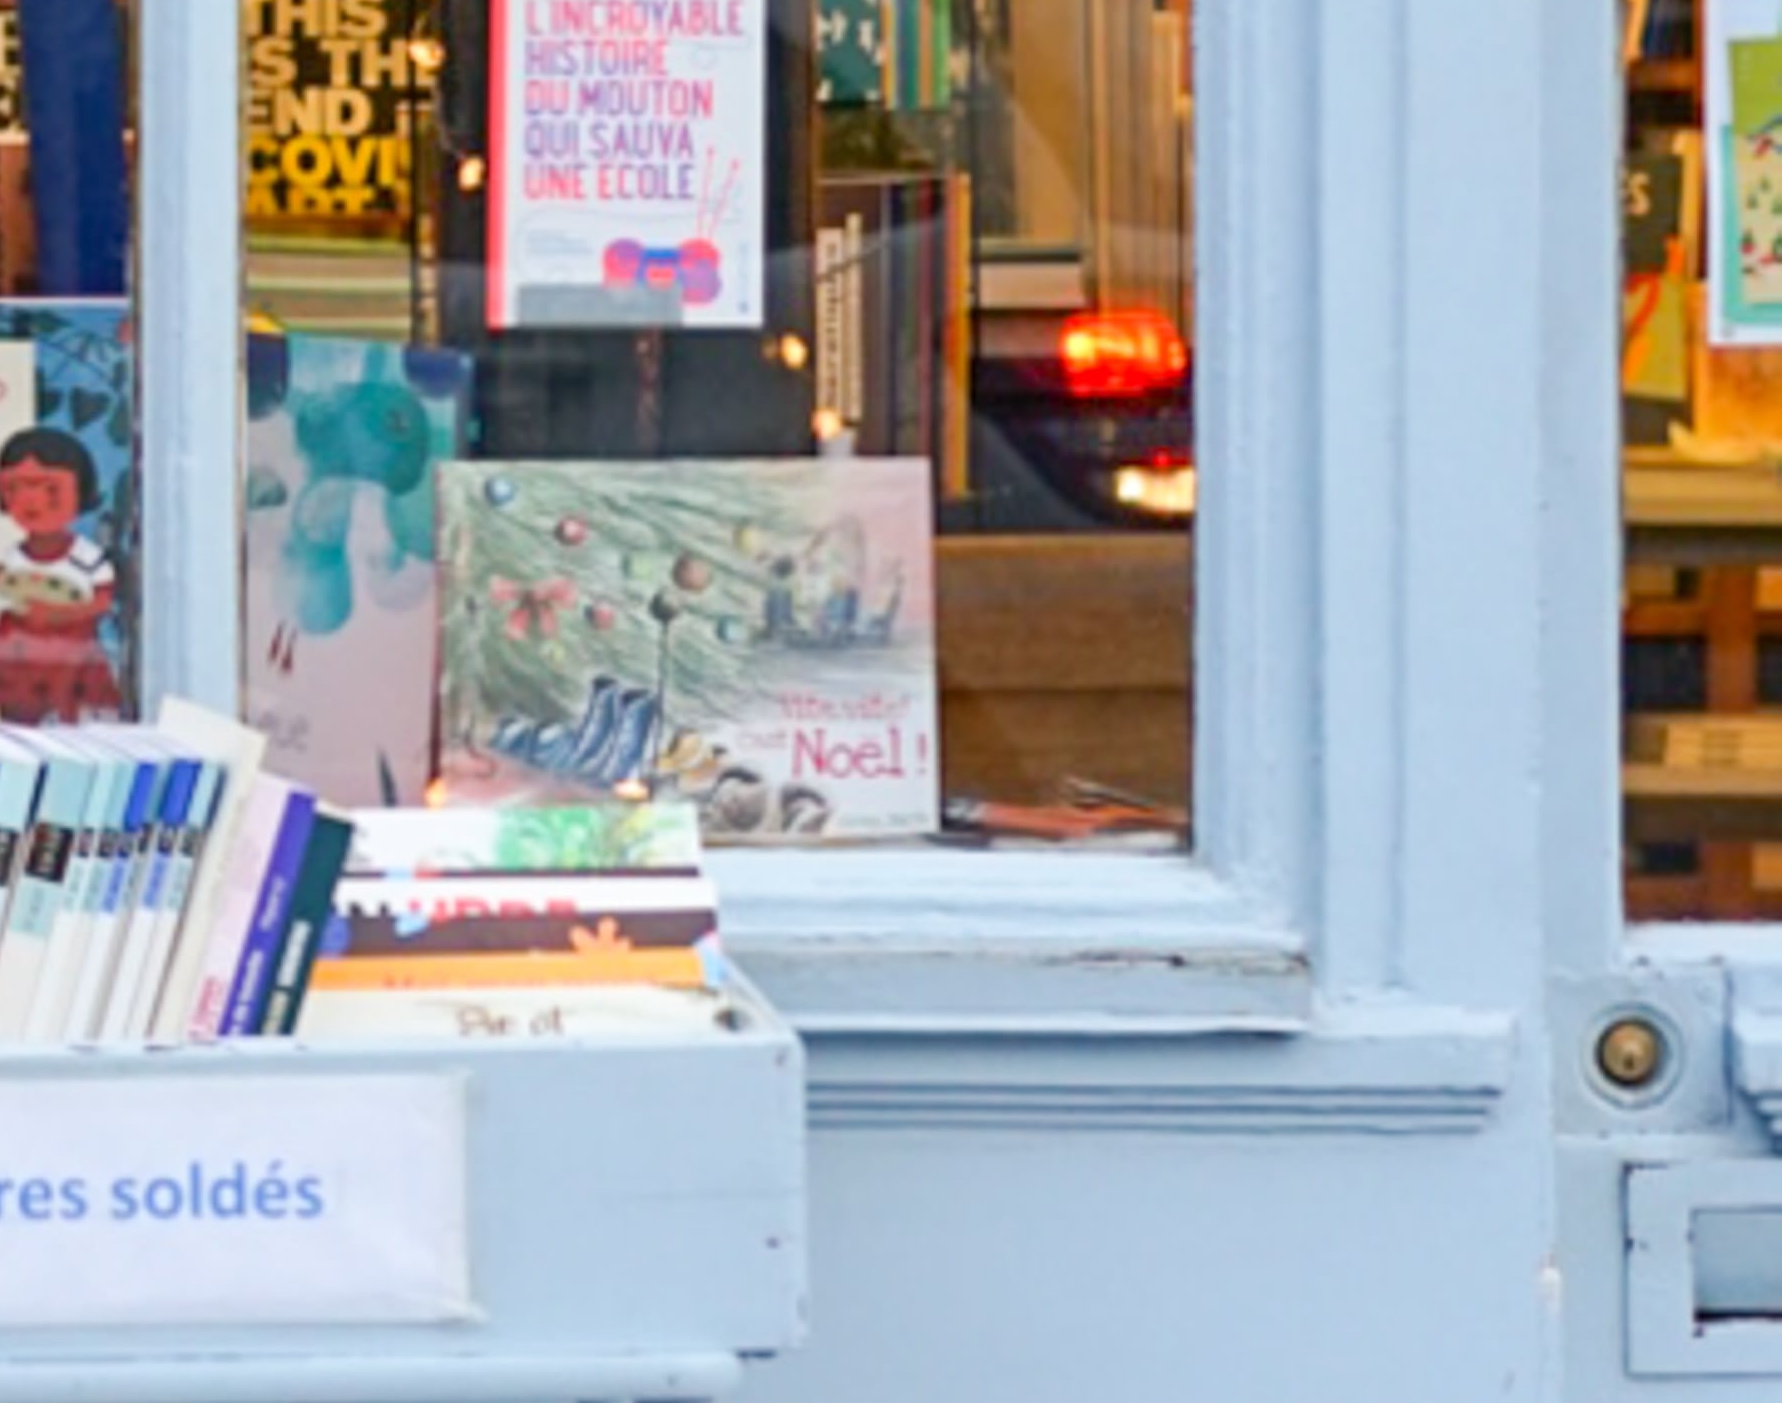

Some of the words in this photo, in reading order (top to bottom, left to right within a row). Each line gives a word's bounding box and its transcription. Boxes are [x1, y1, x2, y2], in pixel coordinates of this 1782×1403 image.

[251, 38, 297, 87] S
[524, 39, 667, 76] HISTOIRE
[524, 80, 570, 116] DU
[579, 80, 712, 118] MOUTON
[524, 122, 580, 158] QUI
[588, 122, 694, 158] SAUVA
[523, 164, 586, 200] UNE
[110, 1160, 325, 1220] soldés
